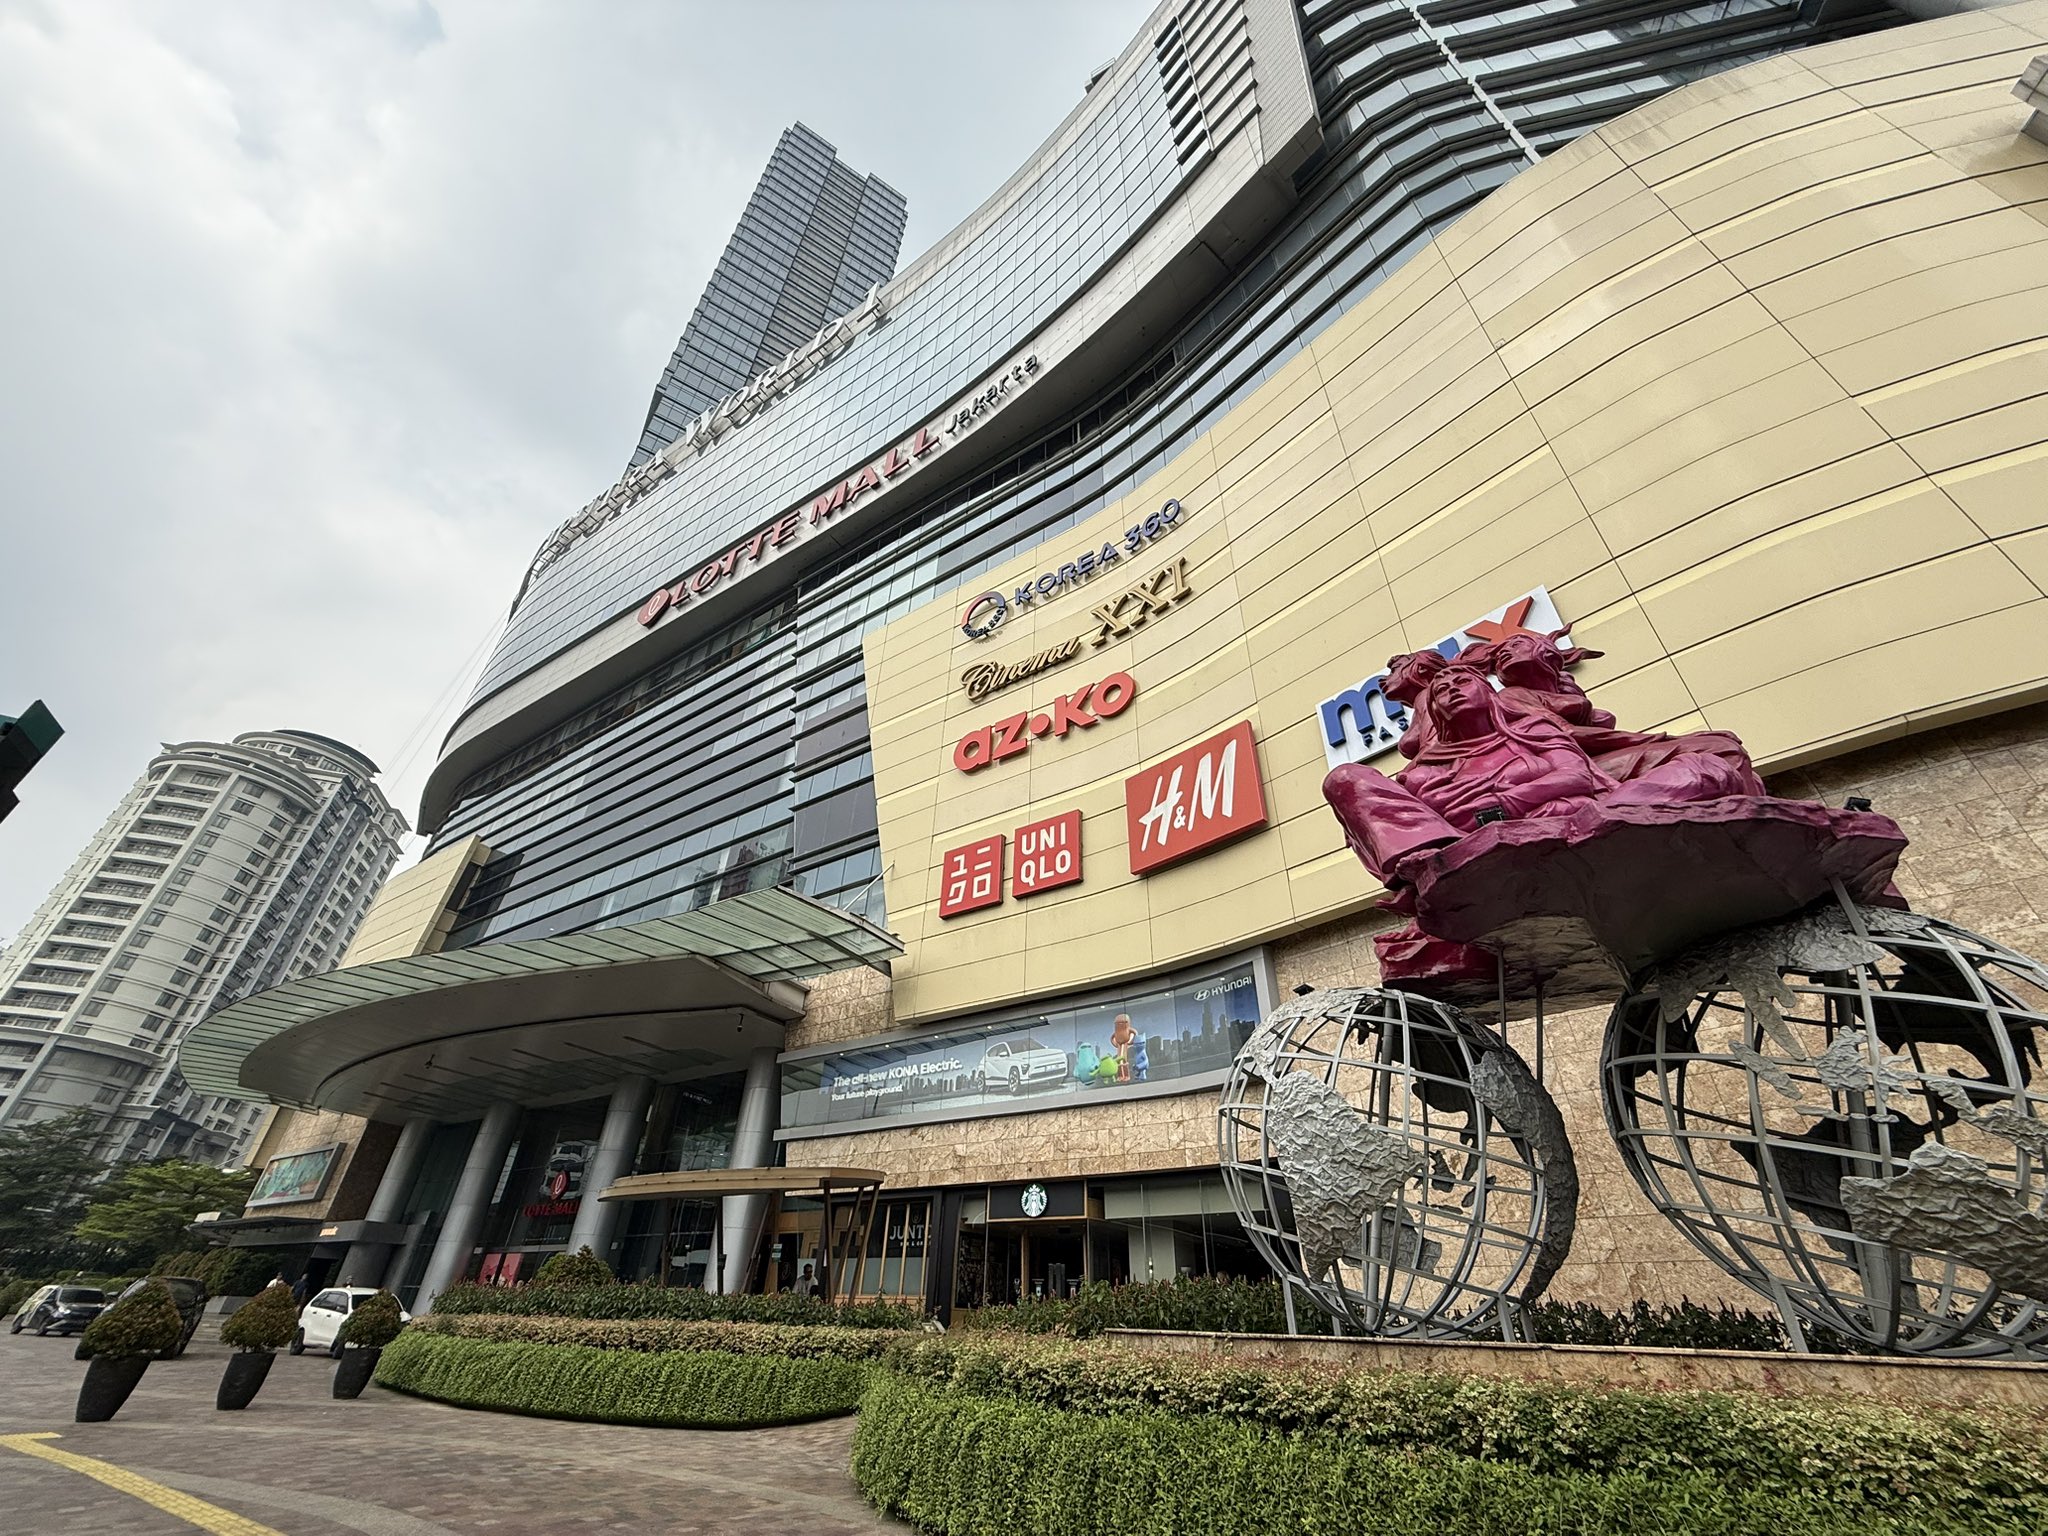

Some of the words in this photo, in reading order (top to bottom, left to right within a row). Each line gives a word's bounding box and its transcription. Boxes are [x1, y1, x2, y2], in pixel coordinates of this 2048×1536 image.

[685, 317, 845, 447] WORLD
[670, 510, 801, 607] LOTTE
[809, 428, 940, 526] MALL
[945, 354, 1038, 434] Jakarta
[1014, 541, 1119, 605] KOREA
[1124, 498, 1181, 551] 360
[961, 636, 1082, 703] Cinema
[1090, 556, 1193, 648] XXI
[1321, 596, 1548, 748] mx
[1363, 718, 1409, 748] FAS
[1138, 738, 1237, 852] H&M
[1020, 849, 1072, 887] QLO
[1021, 821, 1067, 856] UNI
[1211, 975, 1252, 996] HYUNDAI
[831, 1092, 846, 1101] Your
[845, 1089, 865, 1100] future
[834, 1077, 851, 1087] The
[851, 1071, 888, 1085] all-new
[888, 1064, 919, 1079] KONA
[920, 1057, 963, 1075] Electric.
